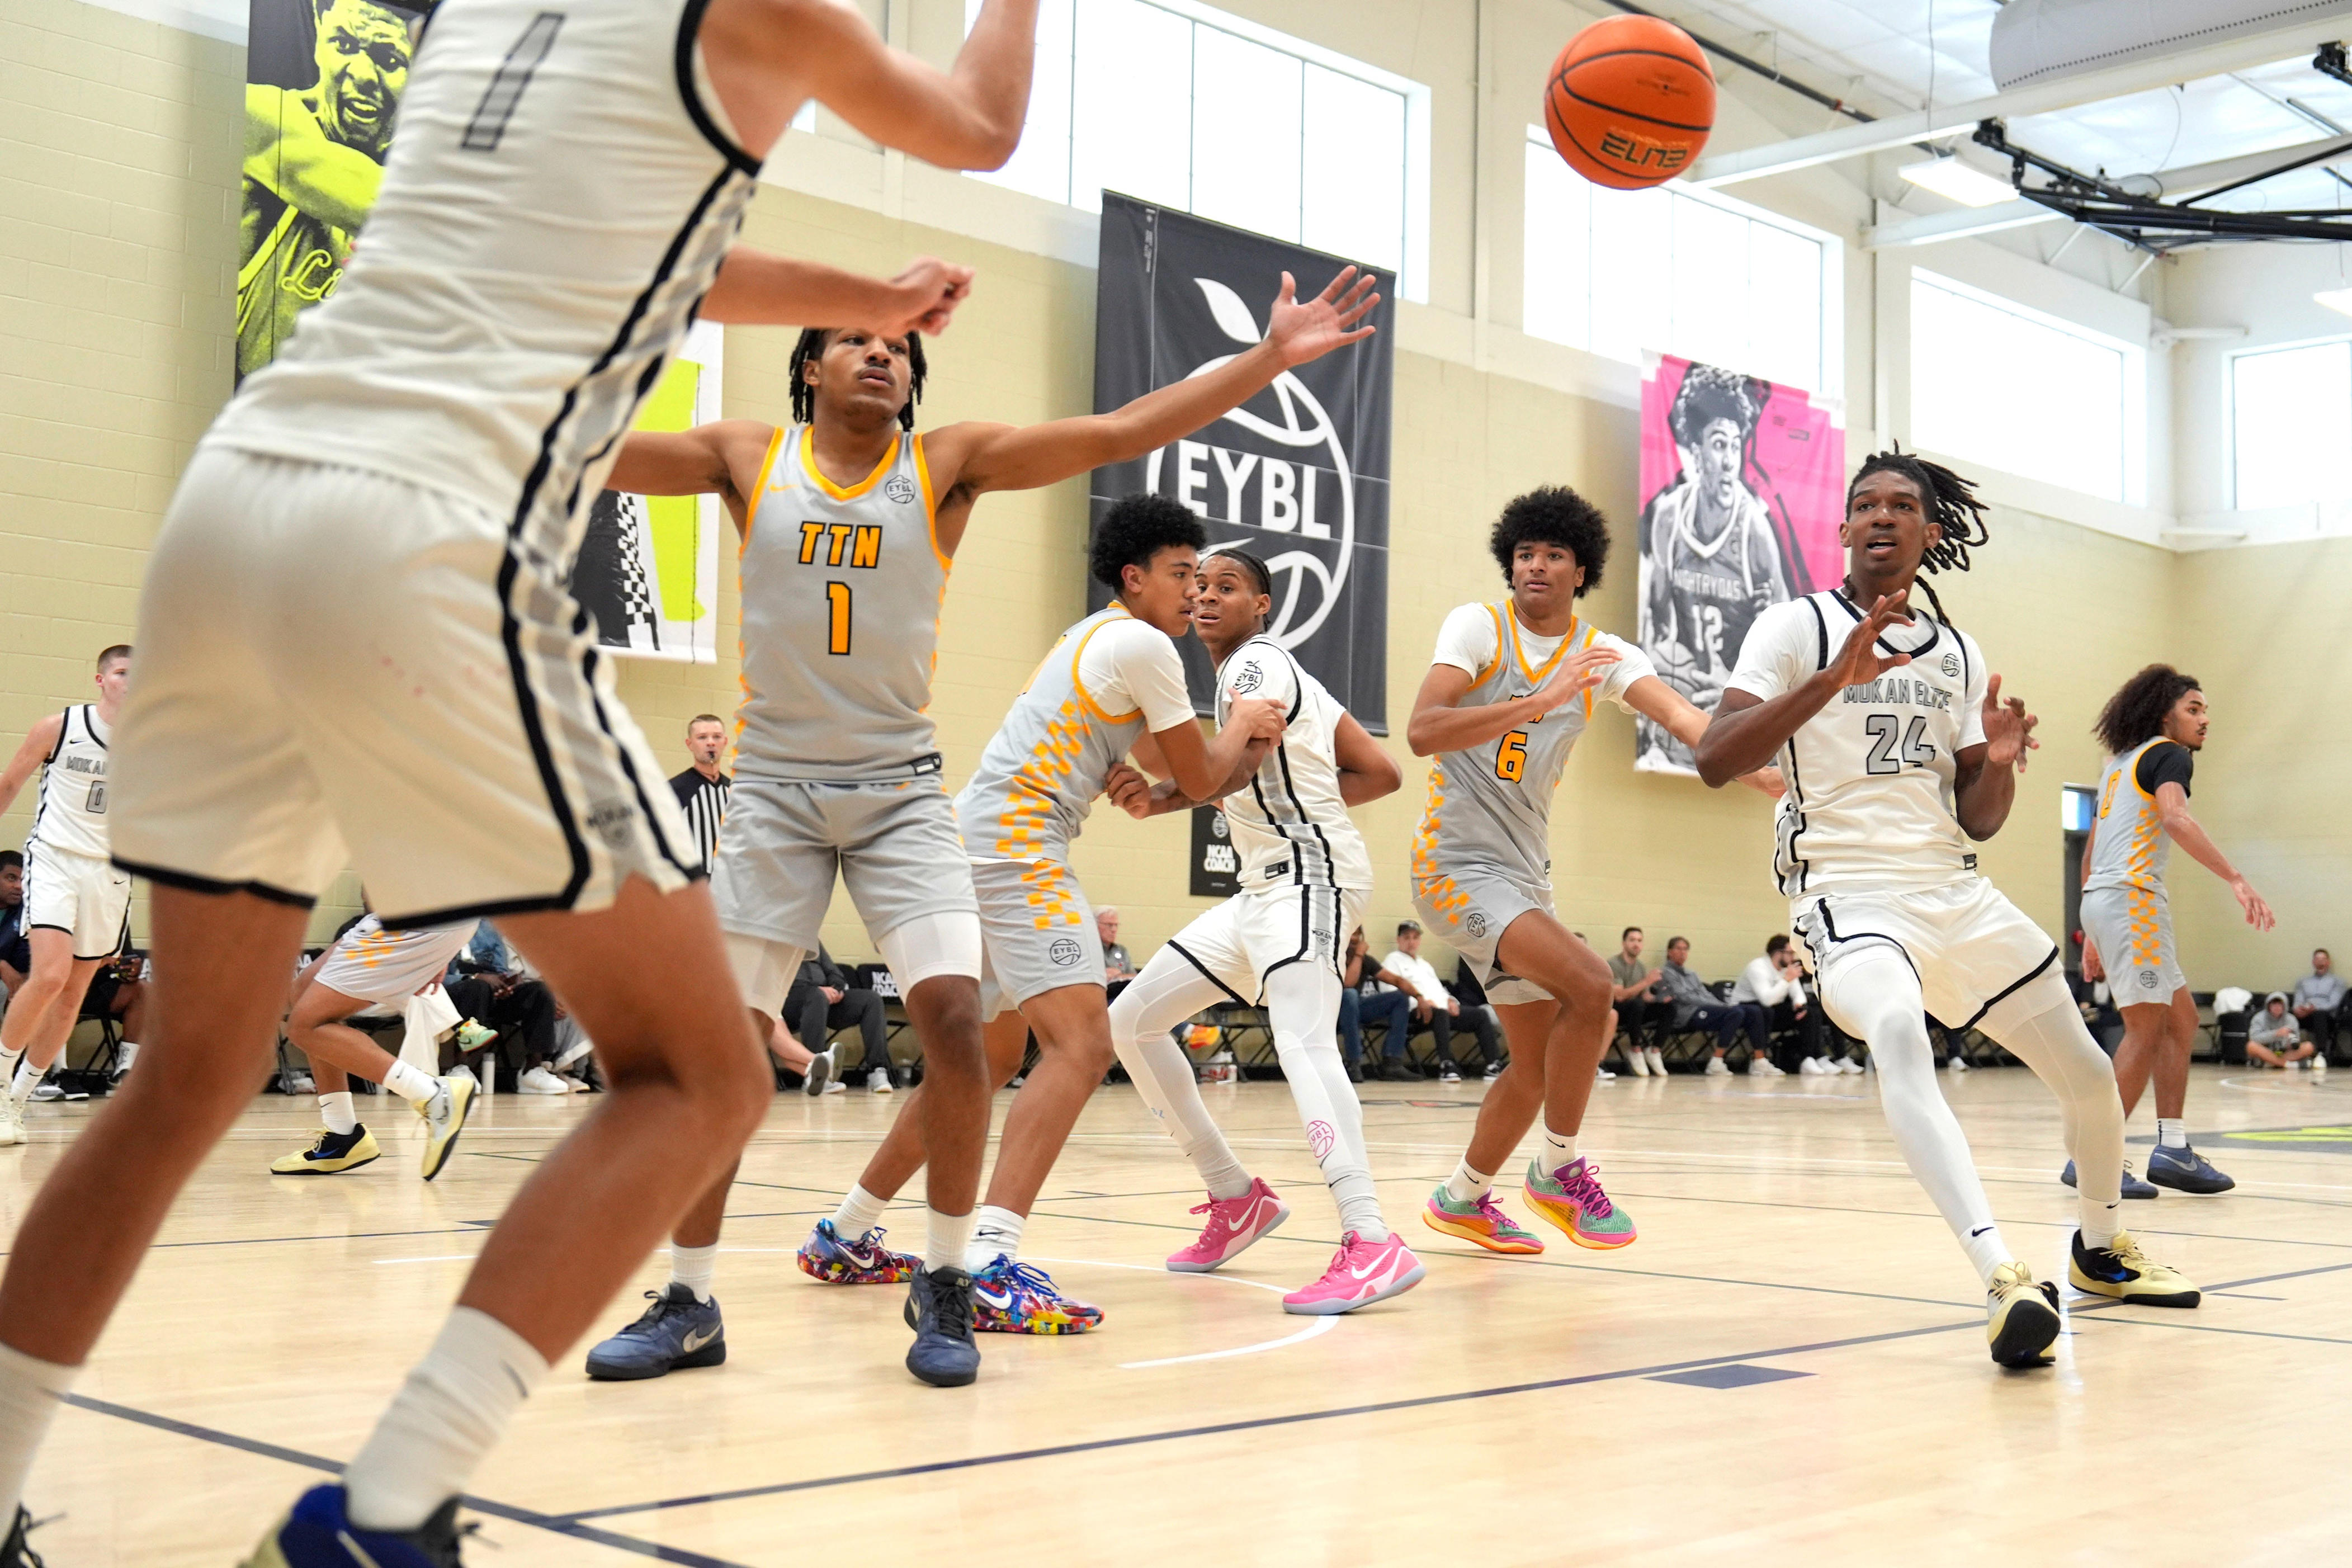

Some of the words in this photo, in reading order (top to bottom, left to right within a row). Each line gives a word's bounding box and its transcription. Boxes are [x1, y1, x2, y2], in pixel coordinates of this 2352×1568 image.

[460, 11, 566, 151] 1
[1600, 132, 1688, 168] ELITE
[1178, 438, 1331, 540] EYBL
[798, 520, 882, 569] TTN
[826, 580, 852, 655] 1
[1691, 604, 1723, 653] 12
[1236, 673, 1258, 683] EYBL
[1844, 678, 1910, 703] MOKAN
[1495, 730, 1528, 783] 6
[1865, 714, 1936, 774] 24
[86, 780, 107, 814] 0
[2100, 769, 2122, 819] 0
[1203, 857, 1235, 873] COACH
[1206, 844, 1234, 859] NCAA
[872, 971, 894, 984] NCA
[872, 983, 899, 996] COAC
